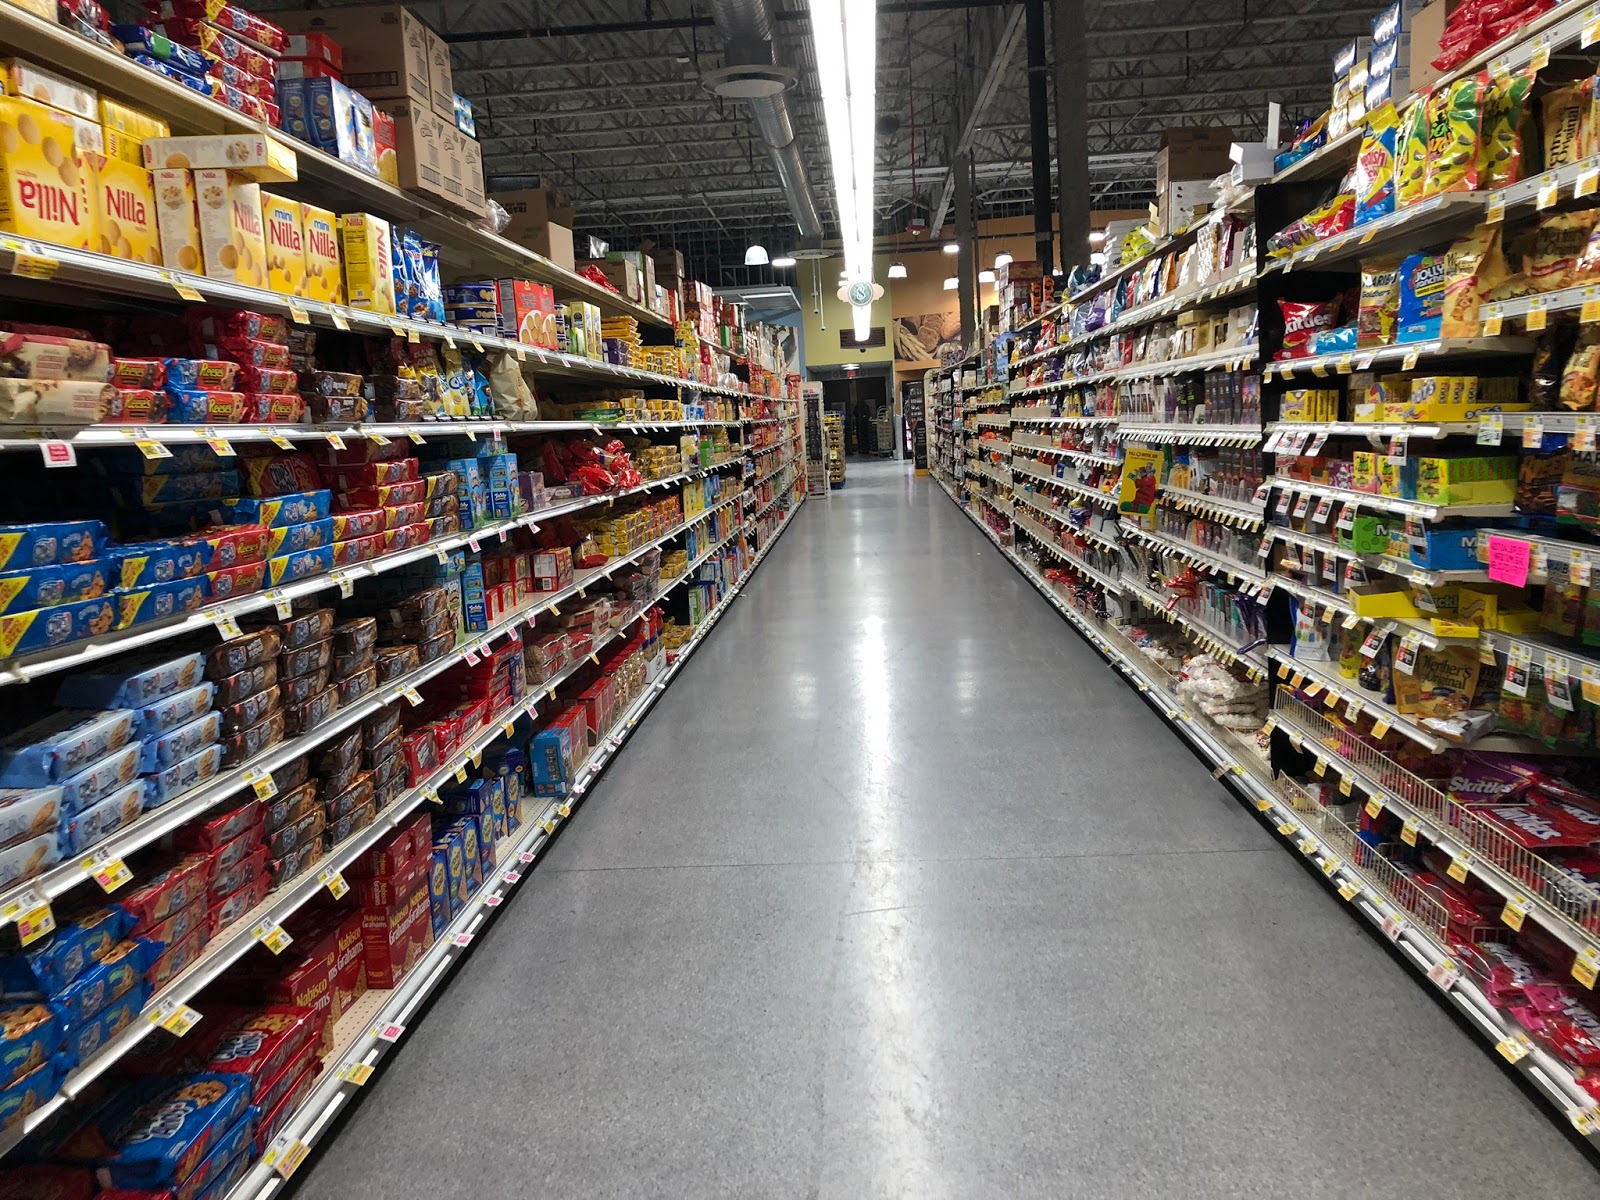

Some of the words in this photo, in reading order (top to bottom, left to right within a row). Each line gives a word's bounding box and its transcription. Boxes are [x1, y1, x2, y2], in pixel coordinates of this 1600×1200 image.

[18, 179, 80, 226] Nilla
[105, 185, 146, 225] Nilla
[274, 209, 292, 221] mini
[233, 199, 261, 236] Nilla
[313, 220, 329, 231] mini
[345, 218, 363, 227] Nilla
[269, 219, 301, 251] Nilla
[309, 229, 337, 259] Nilla
[376, 226, 387, 279] Nilla
[1416, 263, 1444, 282] JOLLY
[1285, 314, 1333, 334] kittles
[1423, 655, 1473, 679] Werther's
[1448, 776, 1514, 794] Skittles
[339, 927, 361, 952] Nabisco
[337, 940, 364, 970] Grahams
[296, 979, 328, 1008] Nabisco
